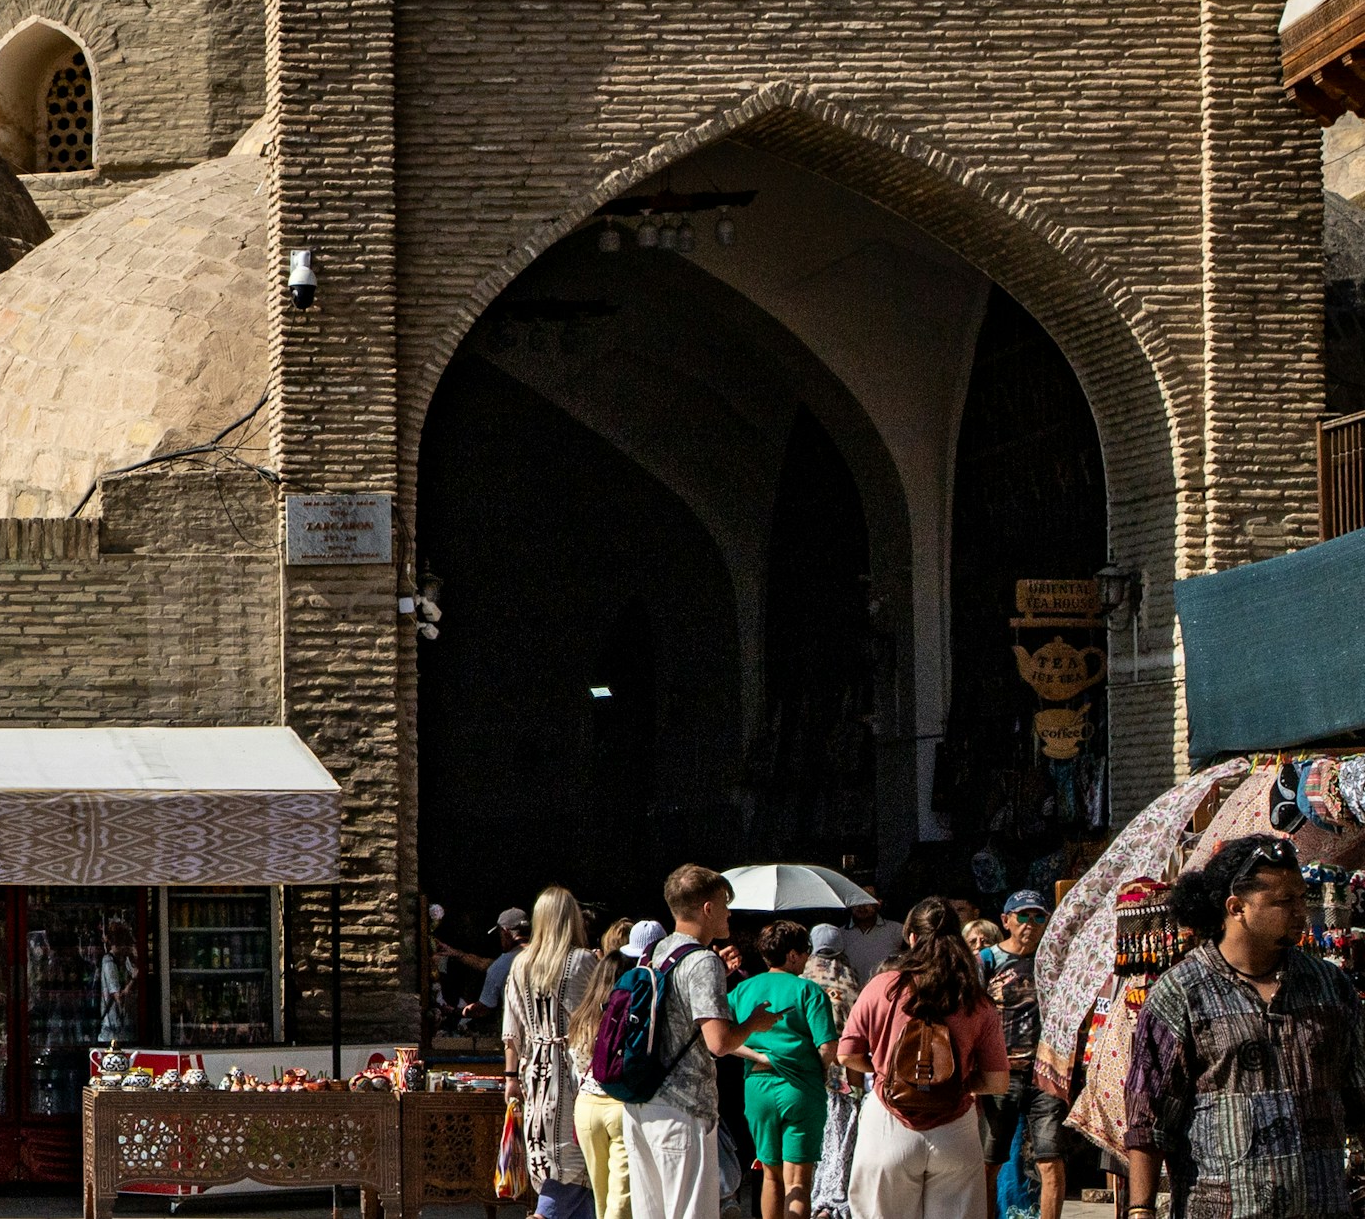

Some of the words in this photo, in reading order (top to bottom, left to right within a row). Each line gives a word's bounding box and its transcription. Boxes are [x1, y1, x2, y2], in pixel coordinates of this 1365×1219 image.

[1029, 585, 1091, 594] ORIENTAL
[1028, 598, 1051, 608] TEA
[1054, 598, 1095, 608] HOUSE
[1037, 657, 1078, 668] TEA
[1032, 672, 1054, 683] ICE
[1060, 674, 1083, 683] TEA
[1041, 728, 1081, 738] coffee
